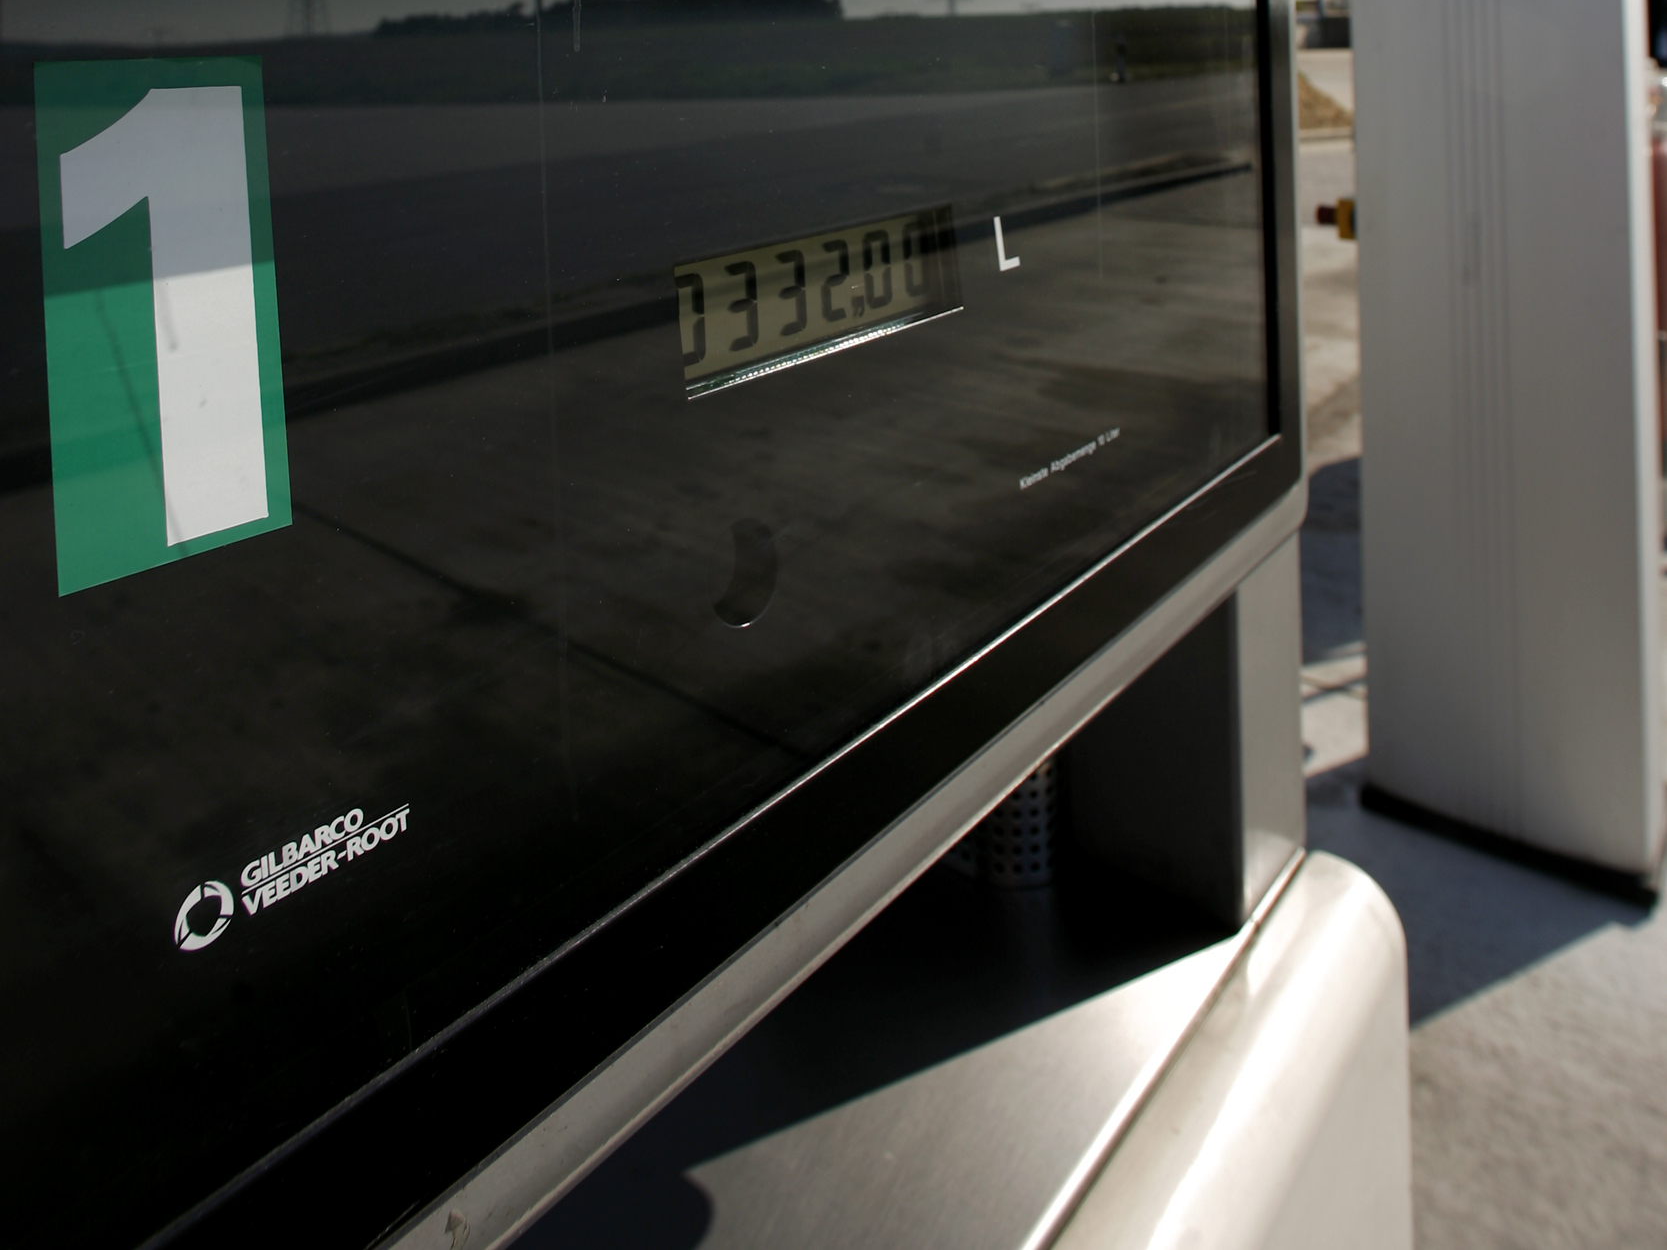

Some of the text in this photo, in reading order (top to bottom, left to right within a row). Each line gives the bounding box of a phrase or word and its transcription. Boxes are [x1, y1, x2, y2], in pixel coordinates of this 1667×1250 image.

[993, 216, 1020, 272] L
[60, 86, 269, 547] 1
[240, 807, 364, 888] GILBARCO
[241, 808, 410, 916] VEEDER-ROOT
